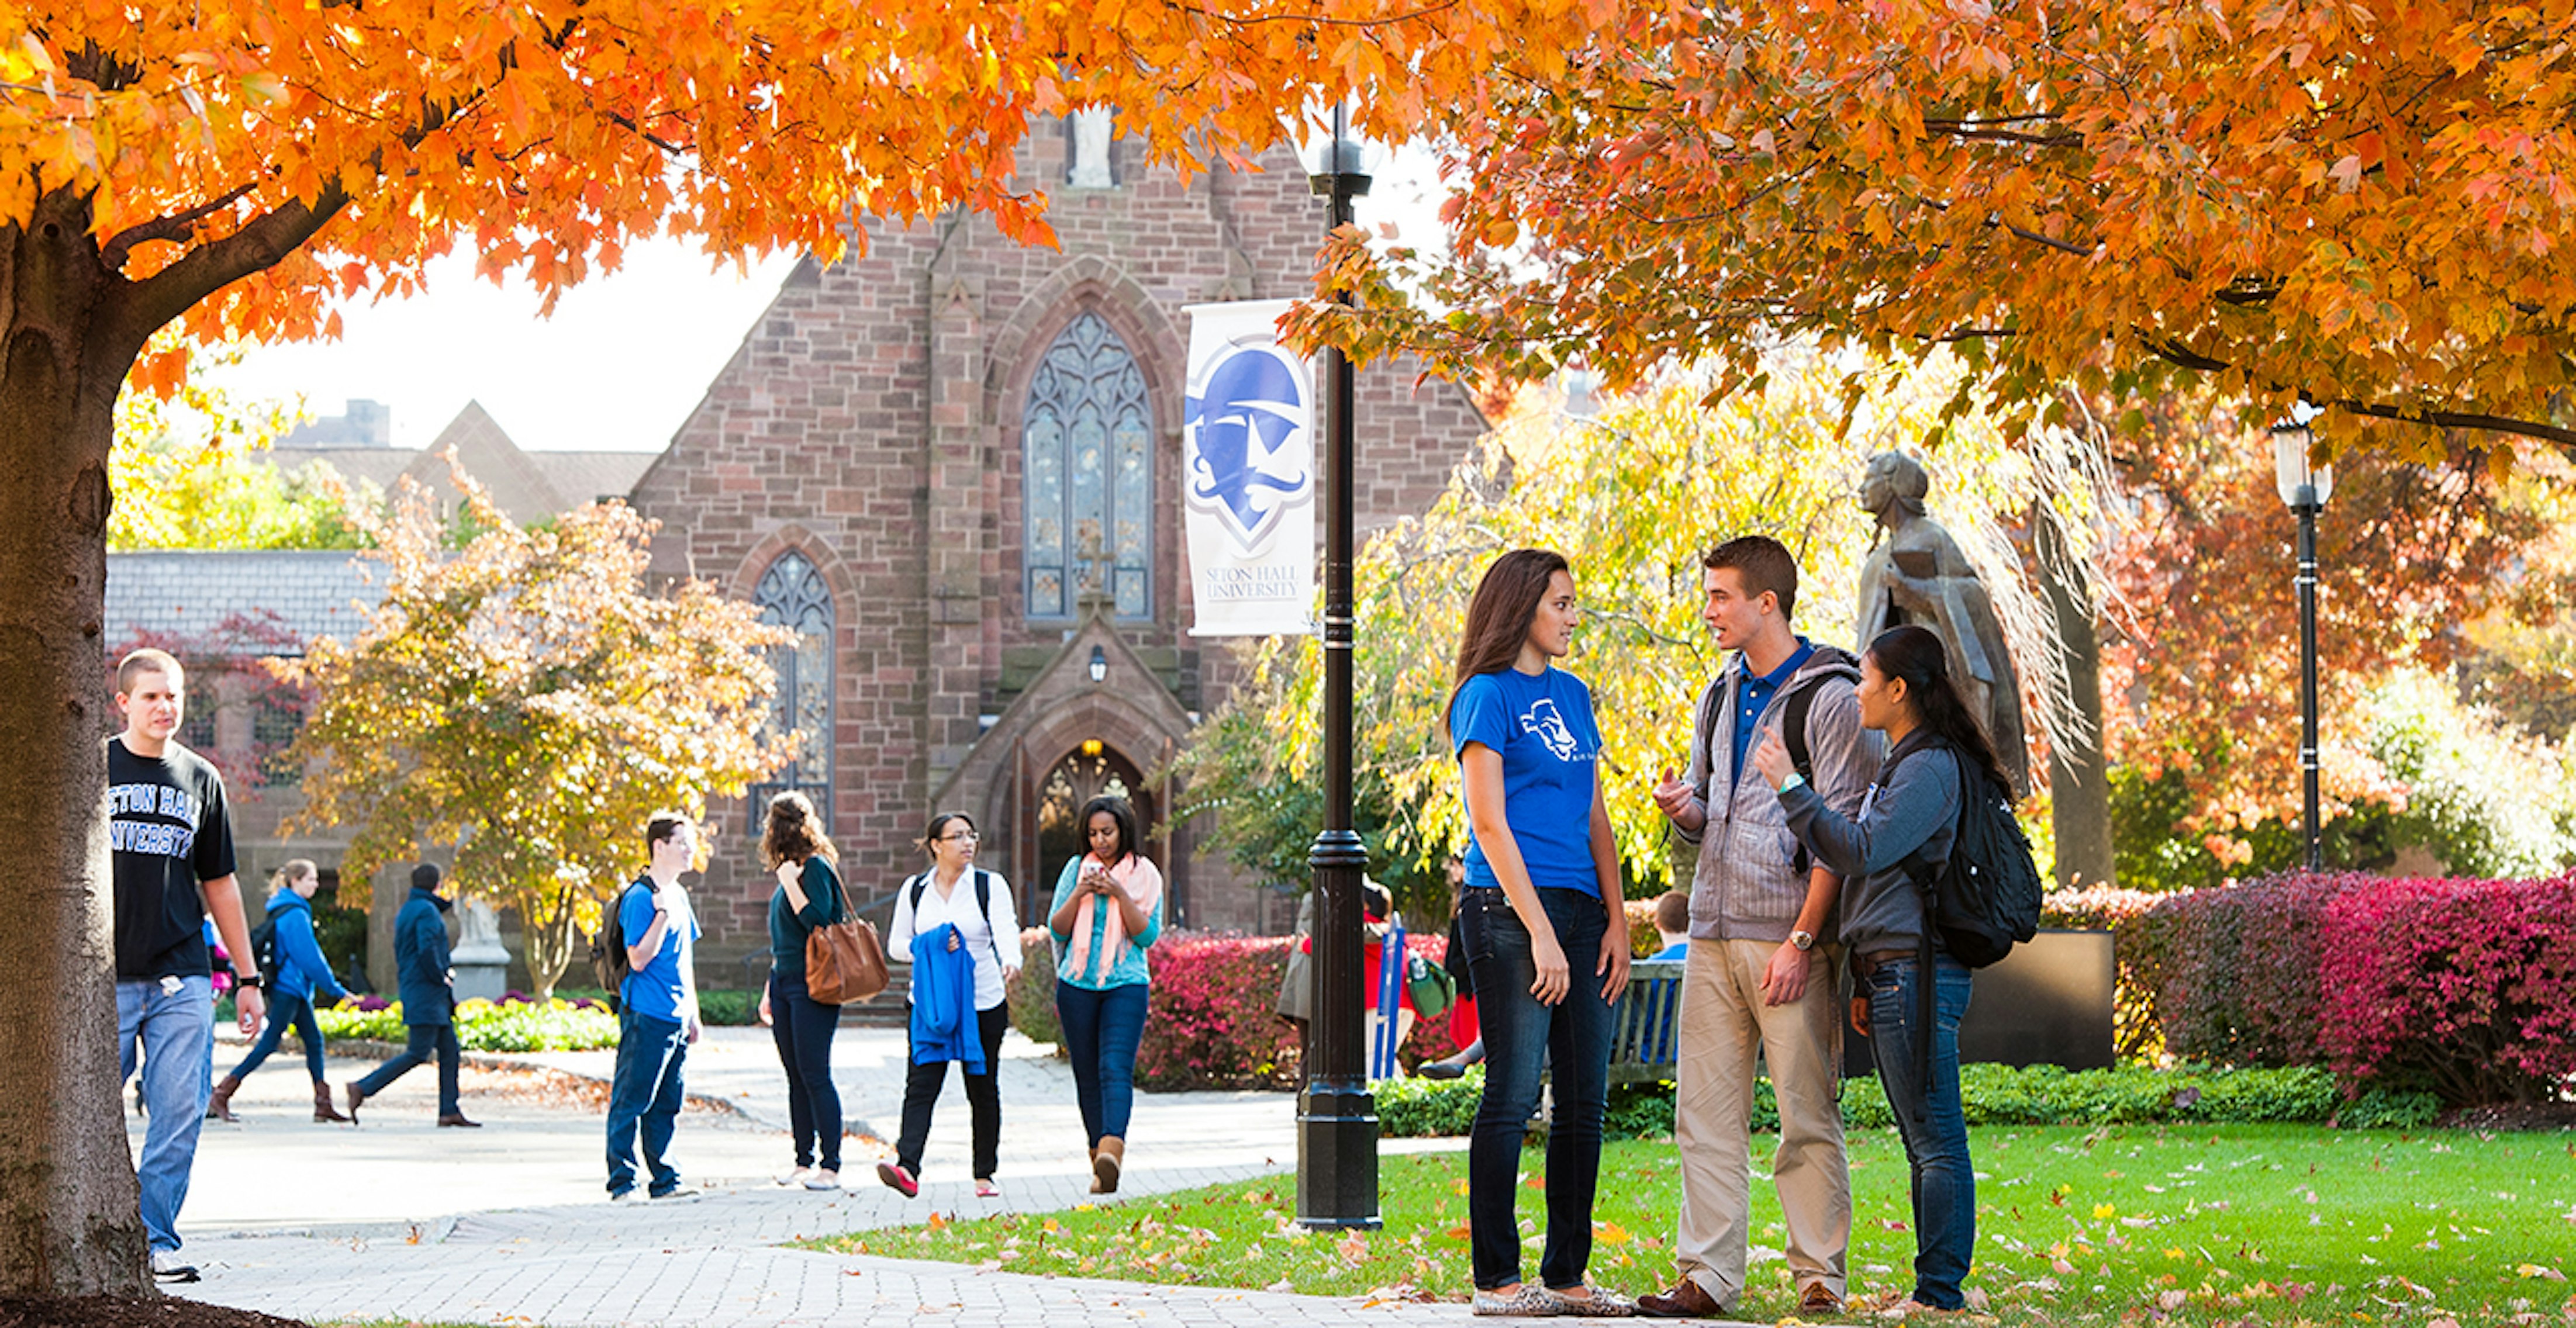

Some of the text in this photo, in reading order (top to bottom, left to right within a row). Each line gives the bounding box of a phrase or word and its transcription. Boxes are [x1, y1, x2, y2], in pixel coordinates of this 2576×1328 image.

[1207, 566, 1298, 582] SETON HALL
[1207, 582, 1298, 597] UNIVERSITY
[108, 784, 202, 834] ETON HALL
[111, 820, 195, 859] NIVERSTY
